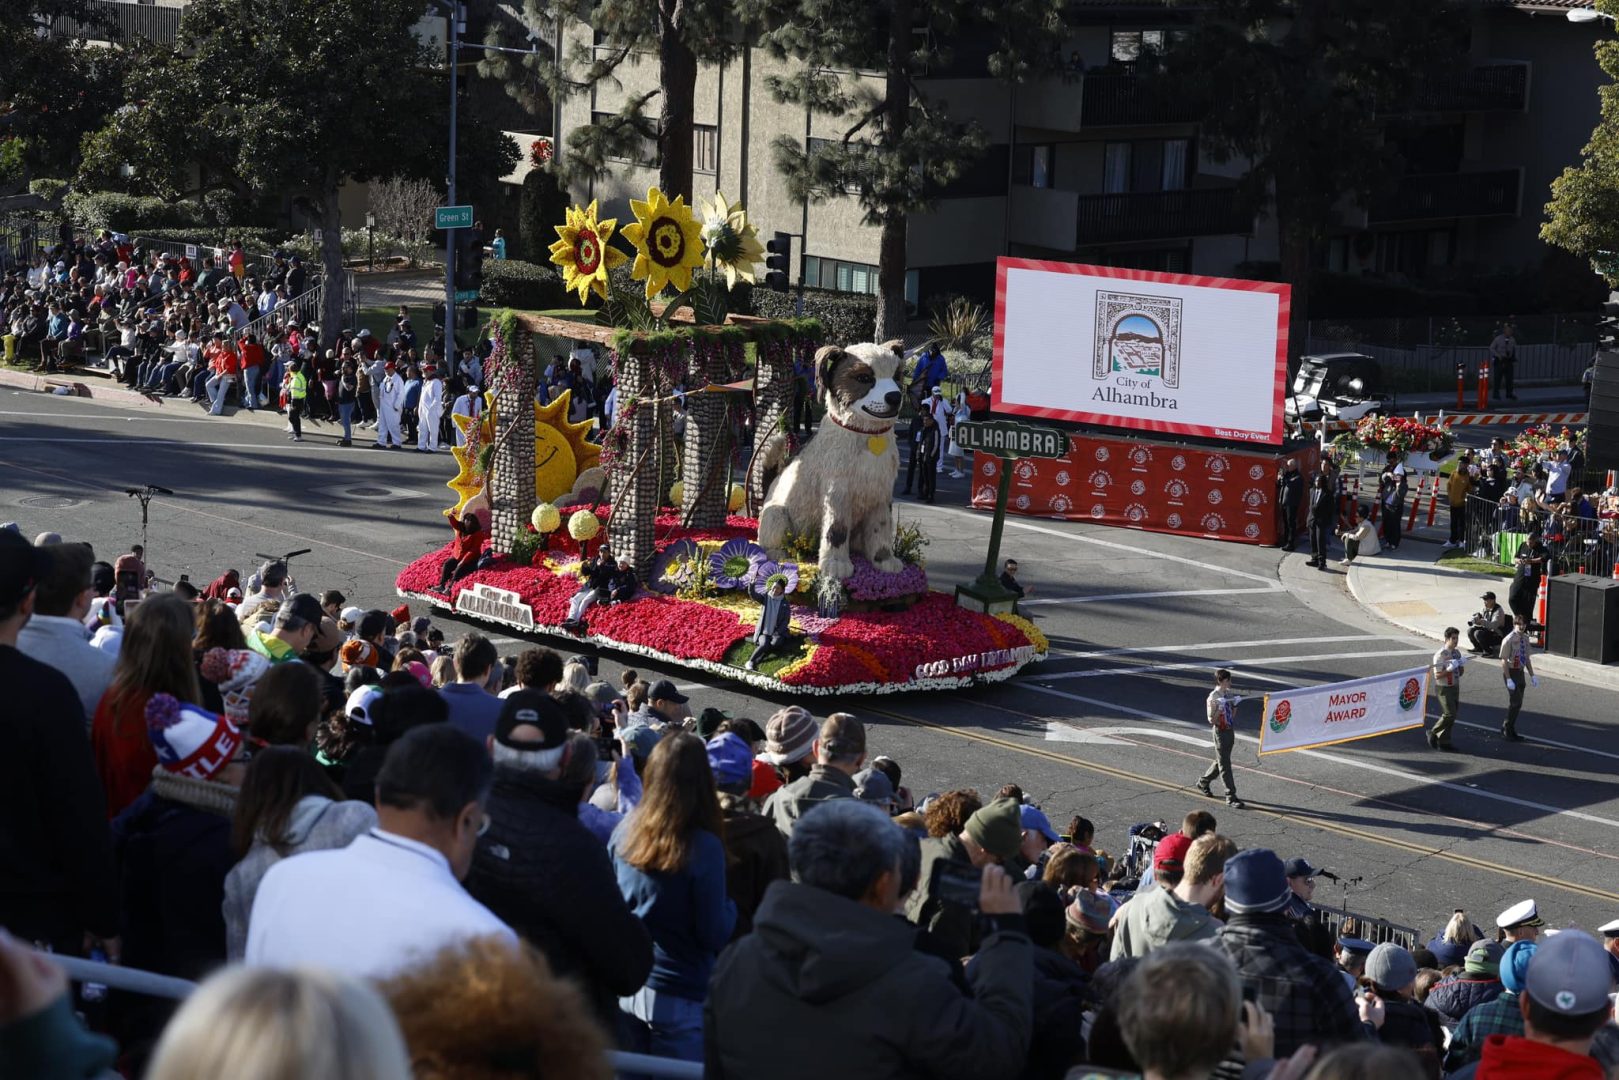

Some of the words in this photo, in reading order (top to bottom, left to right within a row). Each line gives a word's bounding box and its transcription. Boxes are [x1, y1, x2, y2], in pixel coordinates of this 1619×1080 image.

[439, 213, 458, 222] Green
[461, 212, 469, 221] St
[1116, 376, 1138, 390] City
[1140, 379, 1153, 389] of
[1091, 386, 1179, 410] Alhambra
[959, 426, 1055, 454] ALHAMBRA
[1214, 428, 1232, 437] Best
[1233, 431, 1249, 440] Day
[1250, 433, 1270, 441] Ever!
[460, 593, 531, 626] ALHAMBRA
[915, 659, 949, 679] GOOD
[952, 653, 977, 673] DAY
[1329, 692, 1367, 708] MAYOR
[1325, 707, 1366, 724] AWARD
